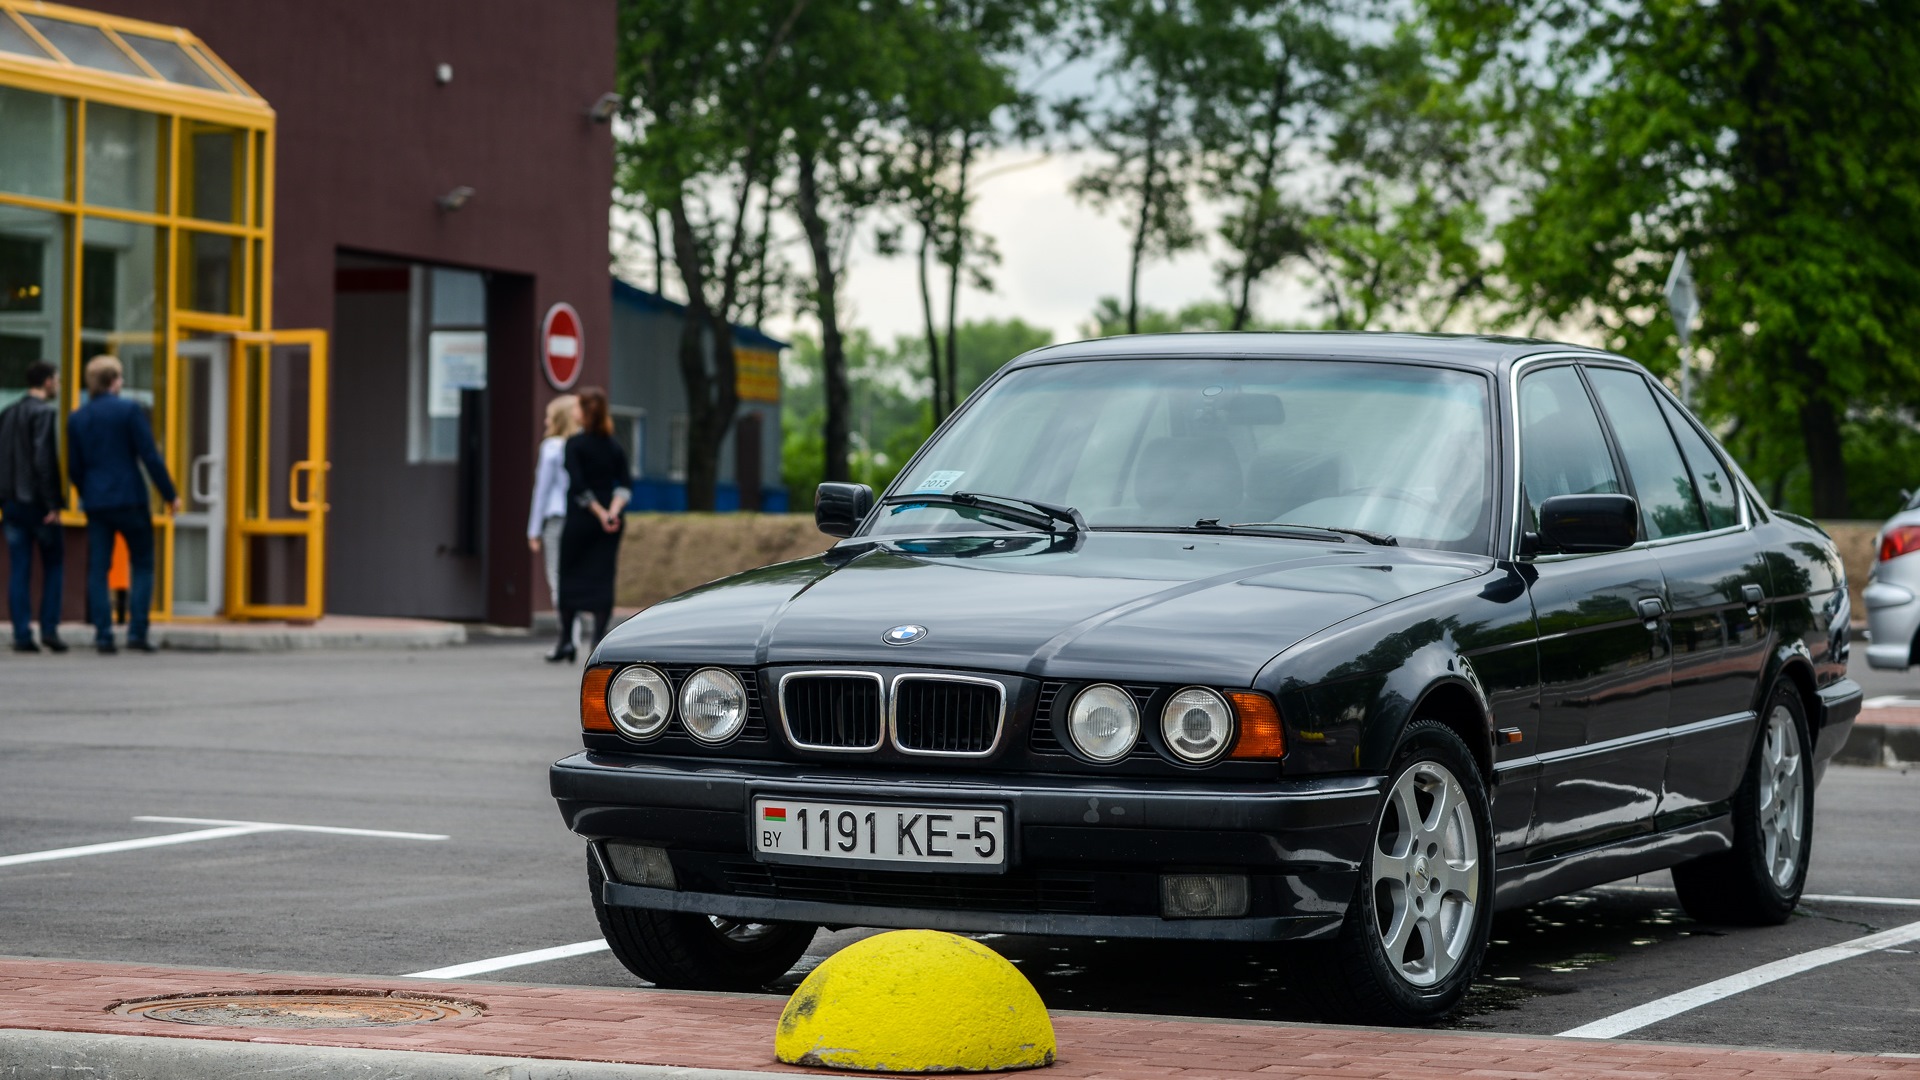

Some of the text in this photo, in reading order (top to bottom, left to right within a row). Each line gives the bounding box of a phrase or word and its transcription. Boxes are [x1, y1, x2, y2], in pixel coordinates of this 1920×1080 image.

[921, 479, 950, 488] 2015
[763, 831, 782, 848] BY
[797, 808, 997, 858] 1191 KE-5
